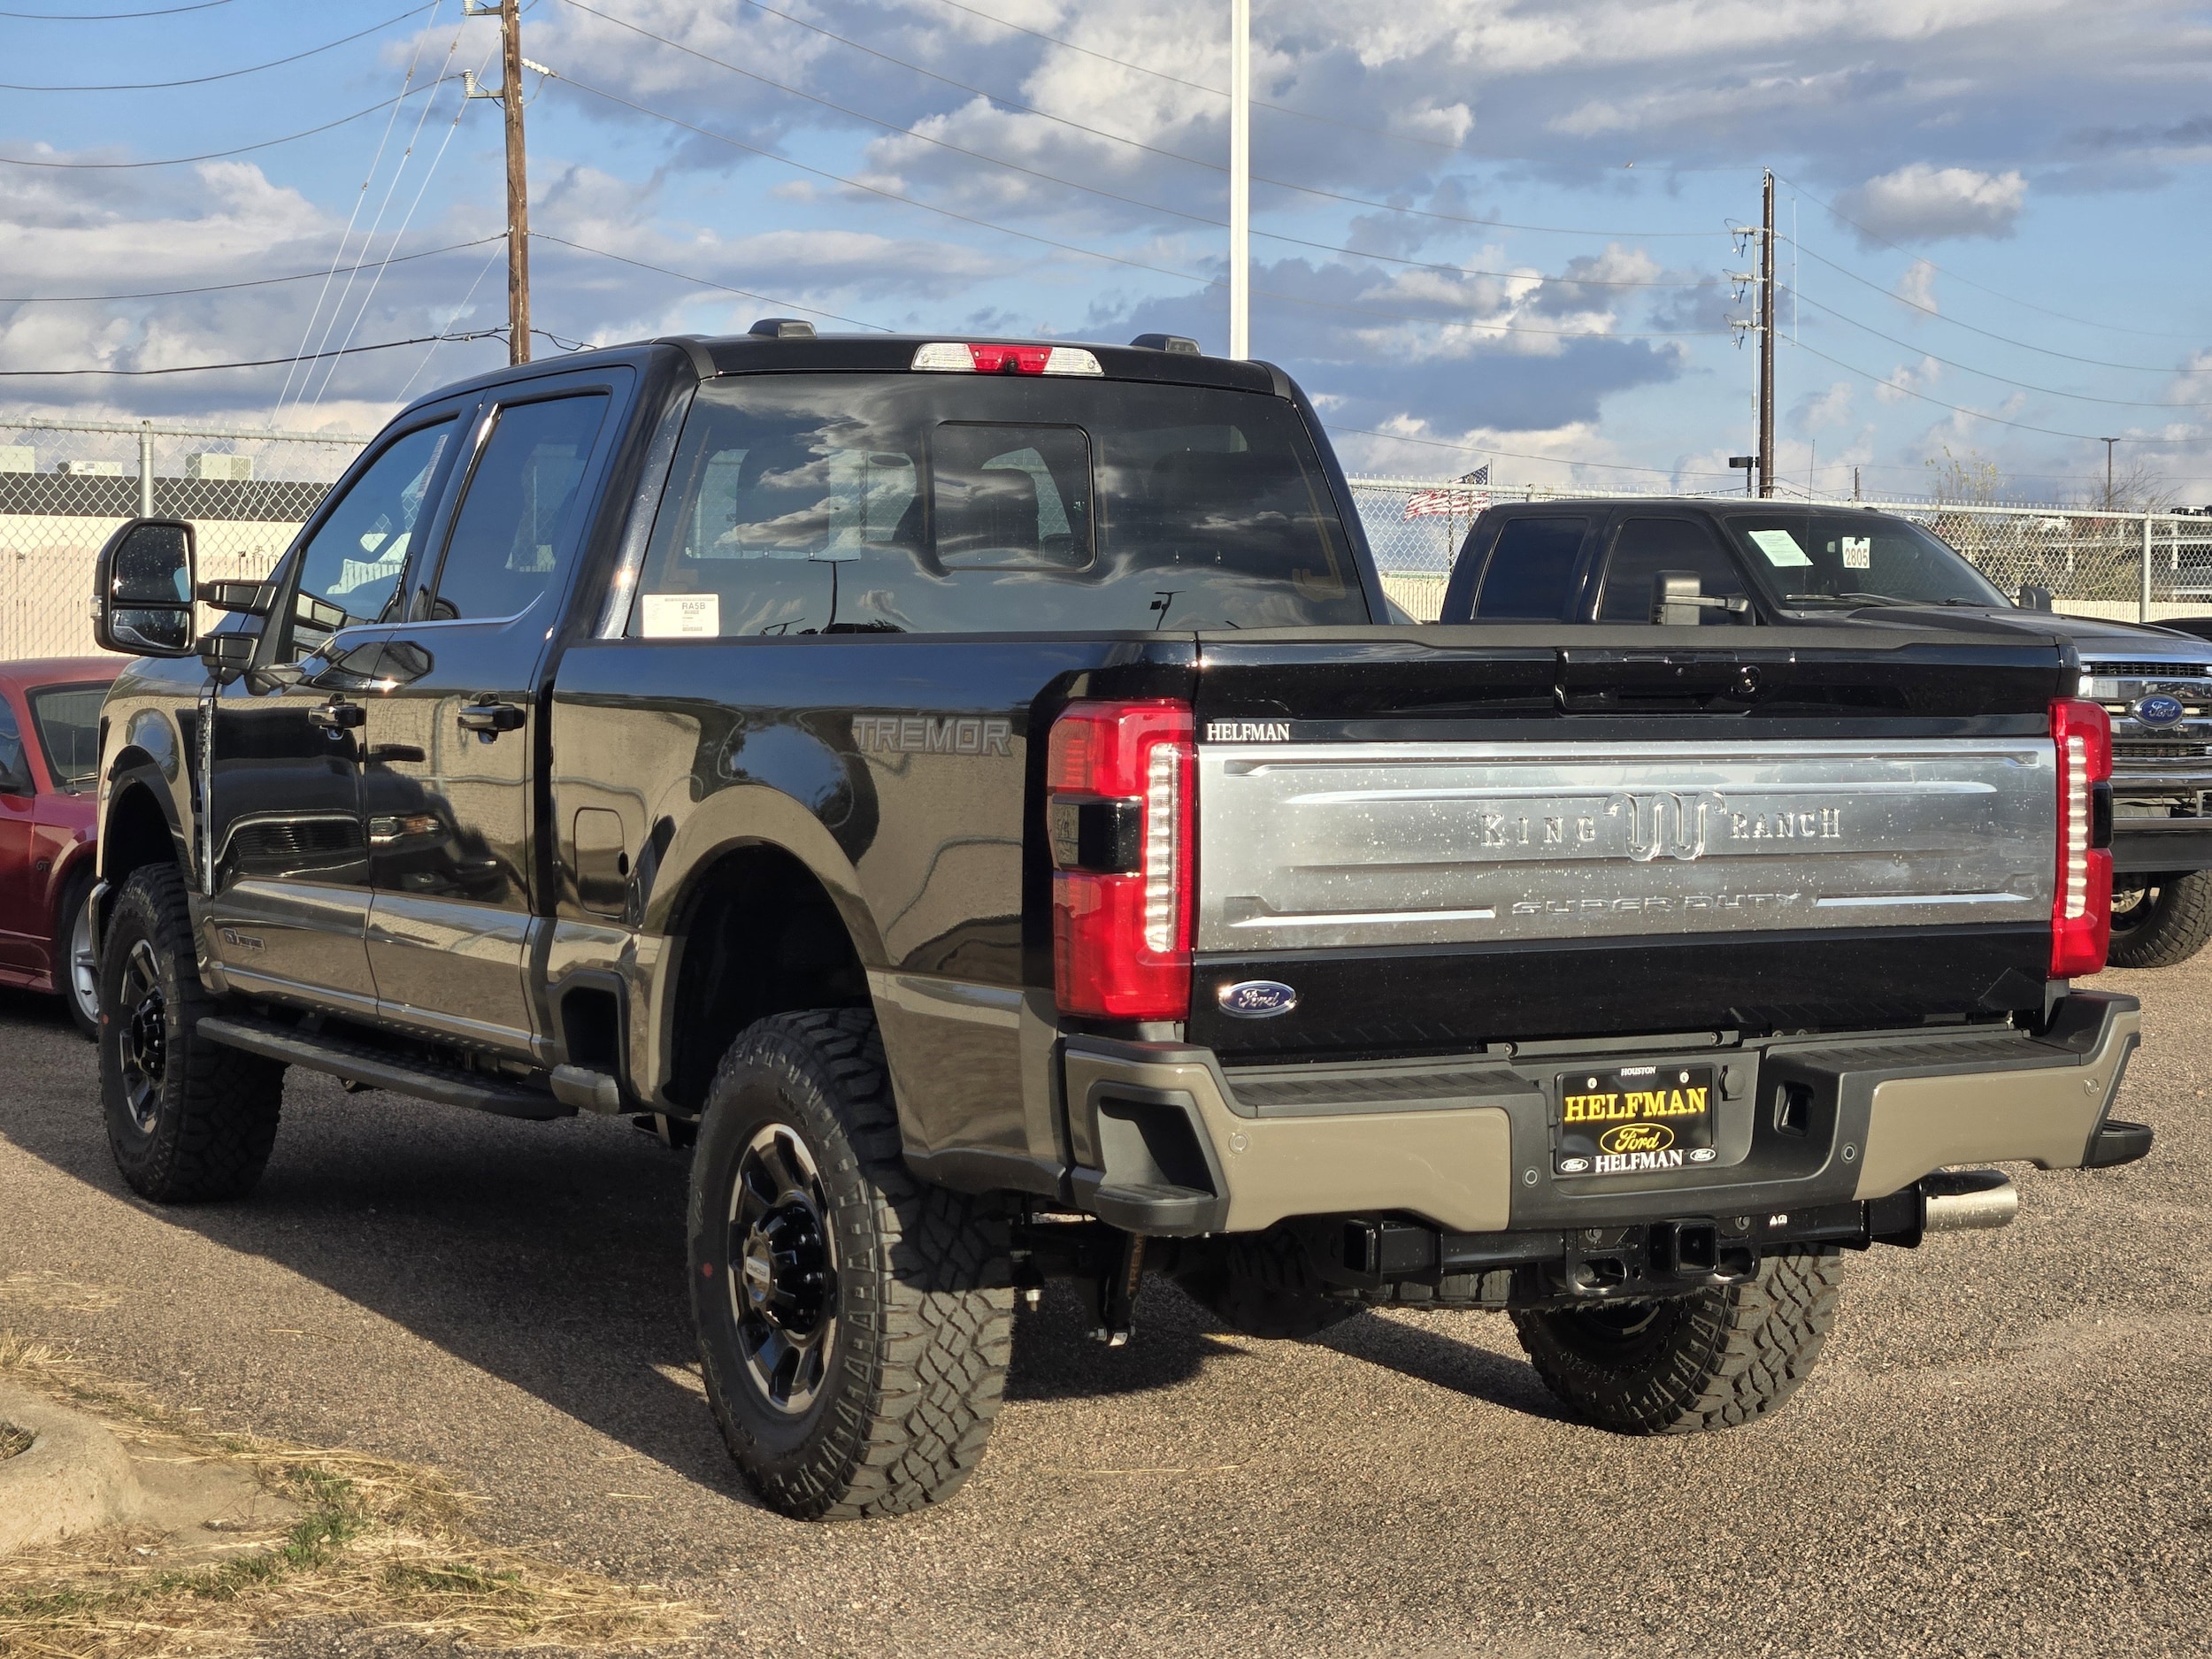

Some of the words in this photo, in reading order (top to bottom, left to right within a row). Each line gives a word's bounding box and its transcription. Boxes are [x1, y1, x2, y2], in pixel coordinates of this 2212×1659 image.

[1845, 547, 1868, 567] 2805
[2148, 700, 2176, 718] Ford
[852, 714, 1013, 757] TREMOR
[1206, 723, 1290, 741] HELFMAN
[1480, 813, 1595, 847] KING
[1729, 807, 1841, 839] RANCH
[1511, 896, 1673, 915] SUPER
[1684, 892, 1801, 910] DUTY
[1238, 987, 1280, 1008] Ford
[1621, 1065, 1656, 1077] HOUSTON
[1564, 1087, 1708, 1122] HELFMAN
[1614, 1126, 1660, 1151] Ford
[1594, 1149, 1684, 1173] HELFMAN
